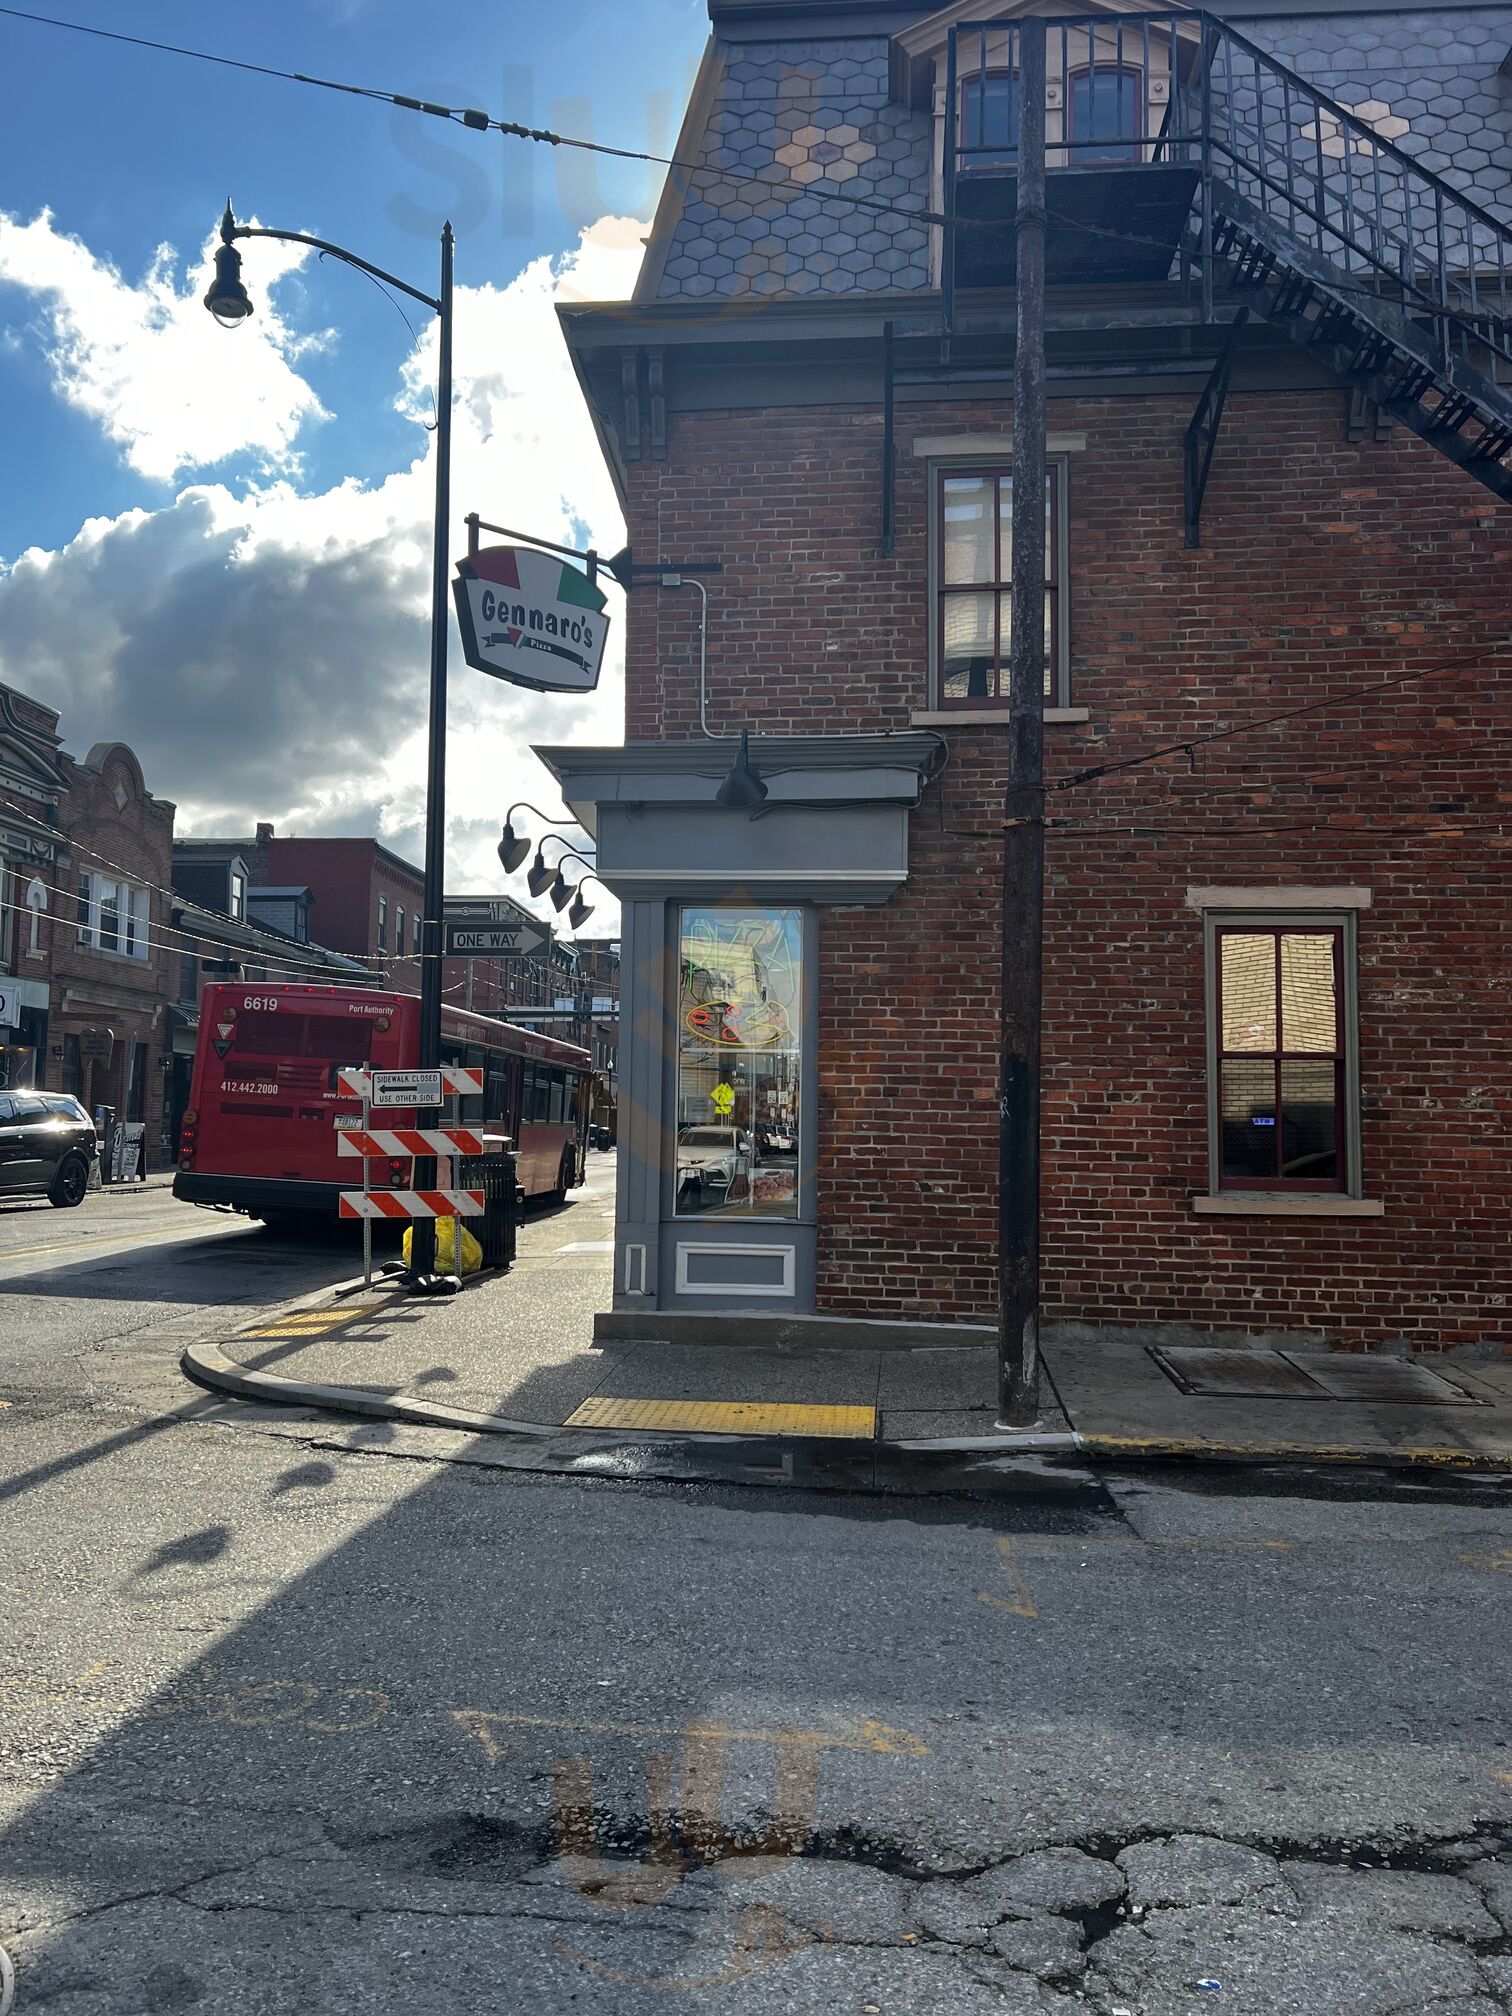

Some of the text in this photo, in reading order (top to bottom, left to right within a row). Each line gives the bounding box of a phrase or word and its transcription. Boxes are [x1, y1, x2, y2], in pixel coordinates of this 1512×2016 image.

[481, 590, 593, 649] Gennaro's
[530, 638, 552, 651] Pizza
[457, 934, 518, 947] ONE WAY
[689, 920, 796, 994] PIZZA
[243, 996, 278, 1011] 6619
[349, 1004, 394, 1015] Port Authority
[377, 1075, 409, 1083] SIDEWALK
[220, 1081, 278, 1094] 412.442.2000
[395, 1094, 417, 1102] OTHER
[420, 1094, 434, 1102] SIDE
